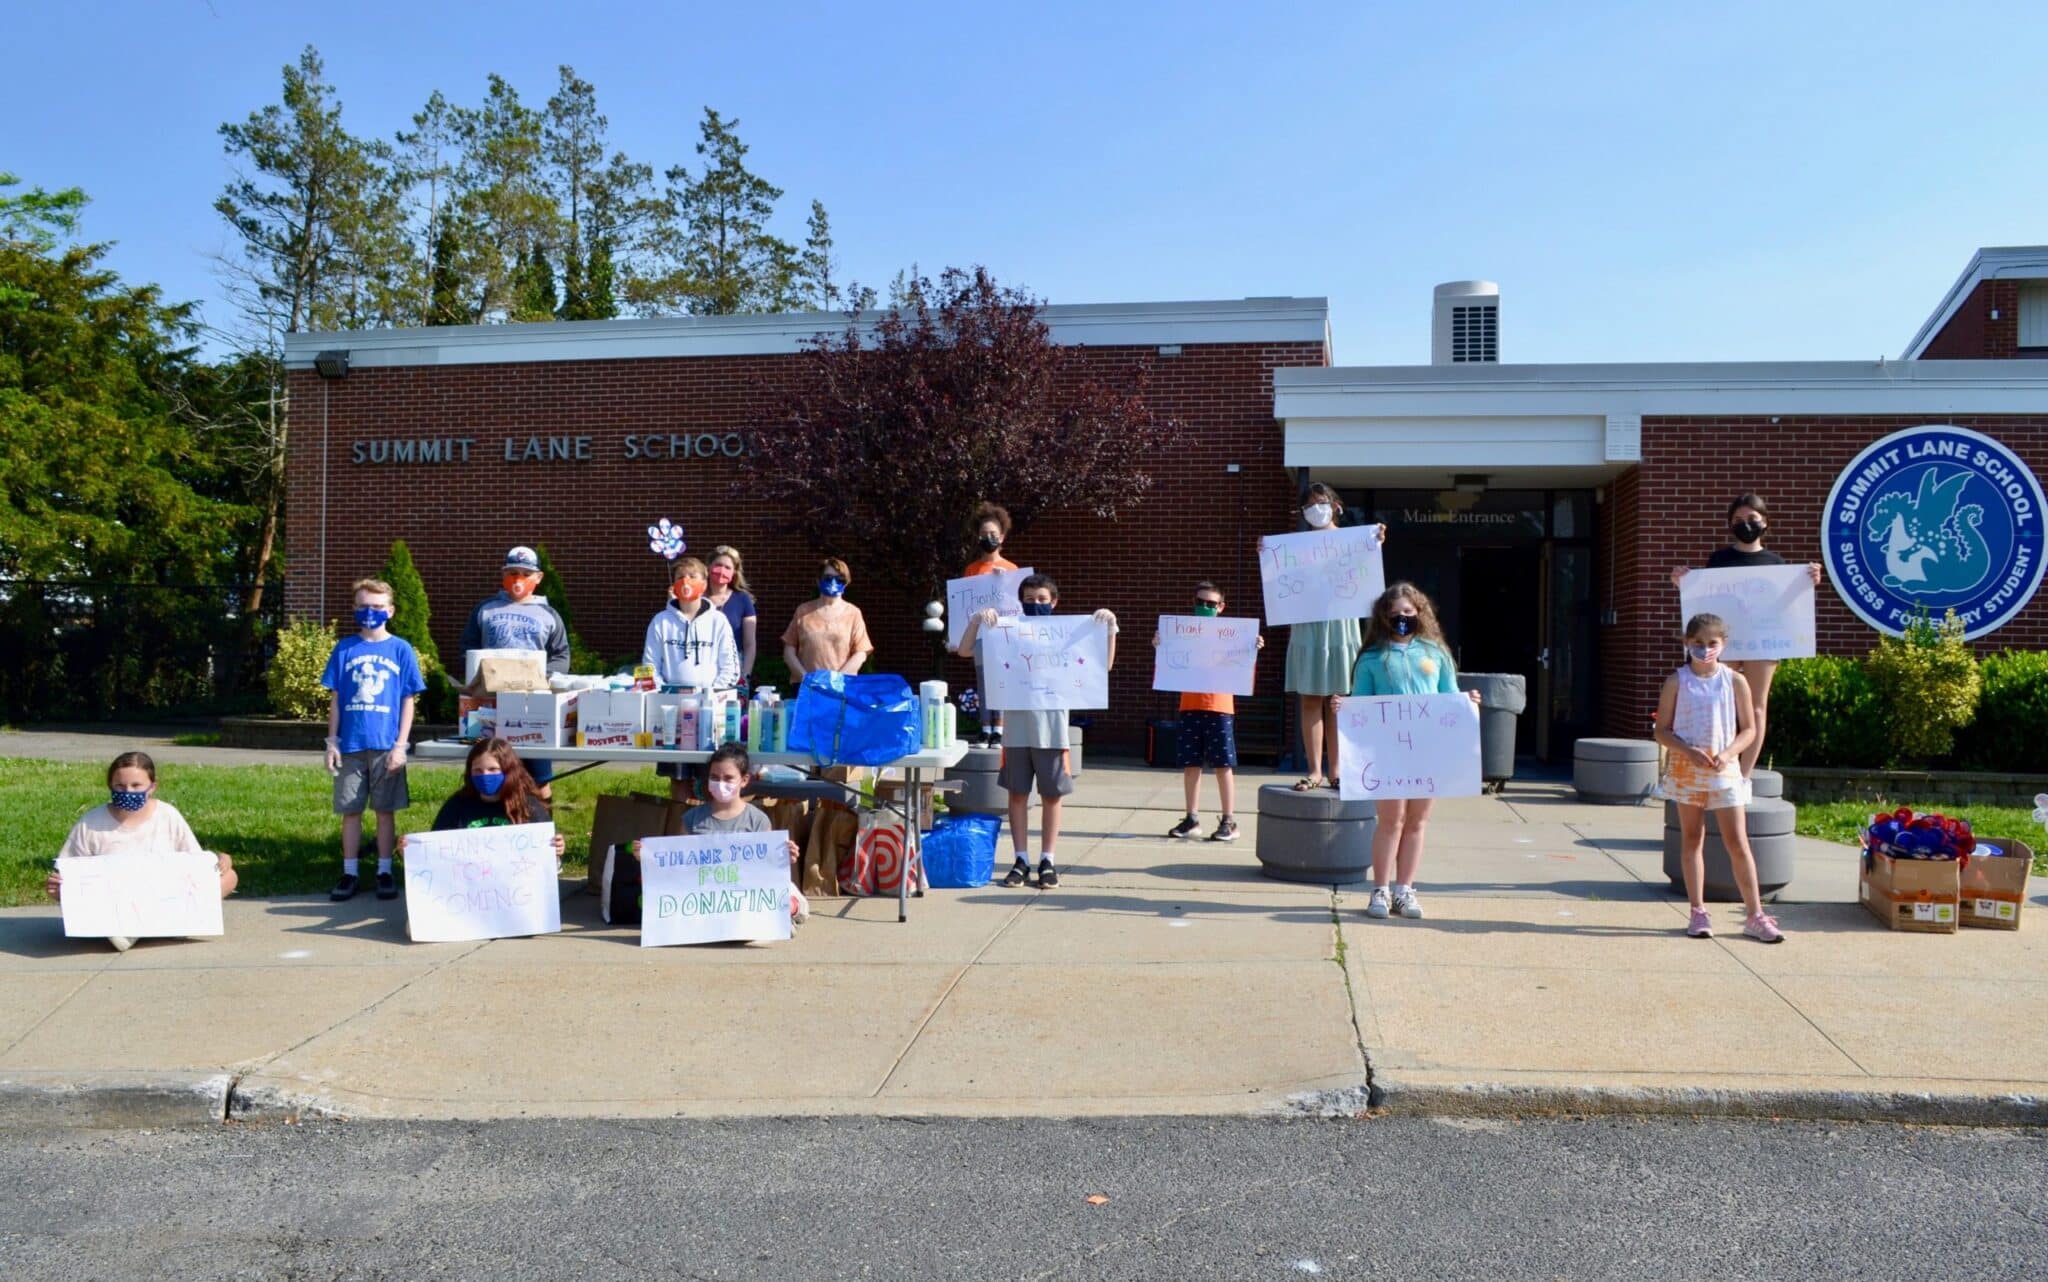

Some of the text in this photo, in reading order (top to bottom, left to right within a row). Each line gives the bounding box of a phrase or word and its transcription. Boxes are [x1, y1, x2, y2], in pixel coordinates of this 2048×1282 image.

[352, 438, 475, 464] SUMMIT
[504, 434, 593, 462] LANE
[1839, 439, 2034, 527] SUMMIT LANE SCHOOL
[1404, 508, 1516, 523] Main Entrance
[955, 583, 1005, 611] Thanks
[1840, 541, 1886, 611] SUCCESS
[1928, 607, 1982, 630] EVRY
[1983, 544, 2032, 613] STUDENT
[1373, 700, 1430, 724] THX
[1397, 730, 1413, 751] 4
[1361, 761, 1435, 793] Giving
[419, 834, 496, 862] THANK
[654, 843, 768, 868] THANK YOU
[452, 859, 493, 881] FOR
[698, 864, 740, 886] FOR
[431, 885, 532, 913] COMING
